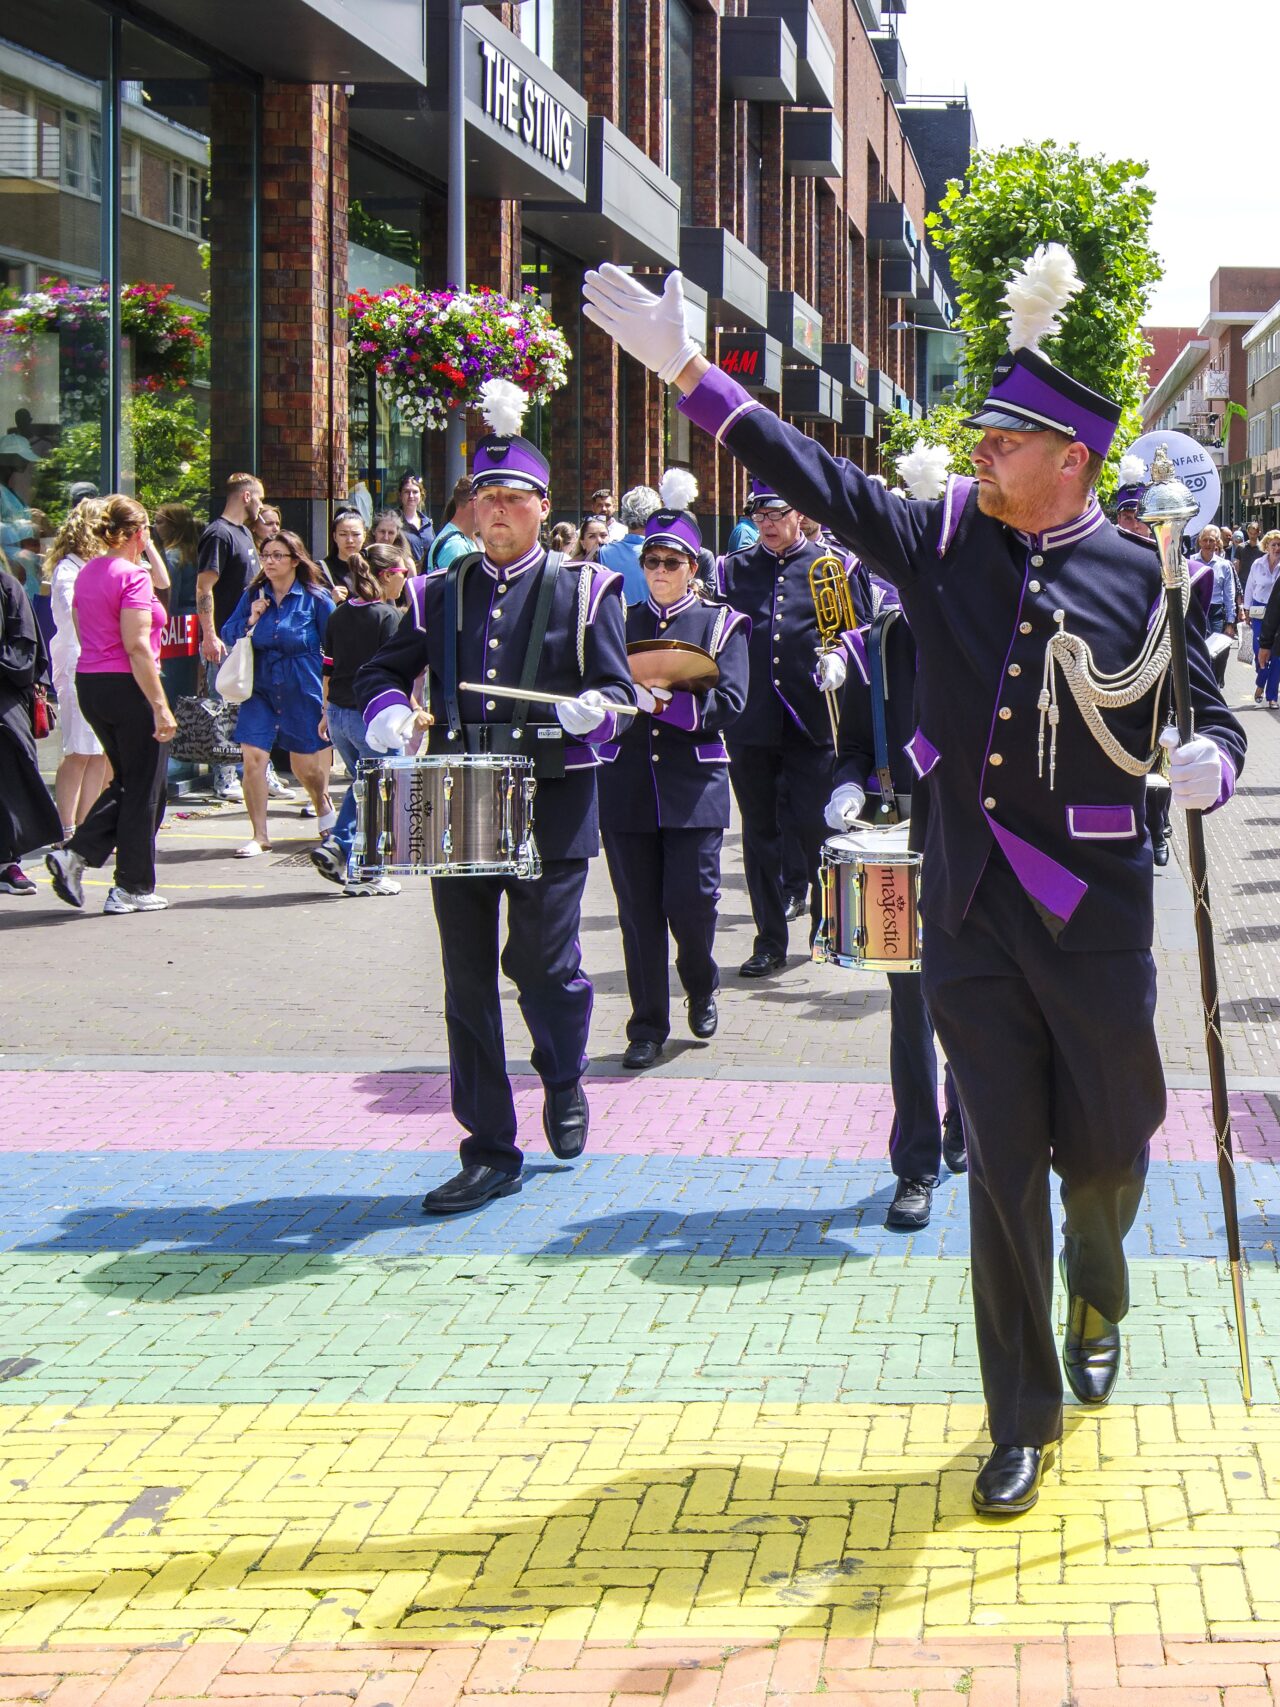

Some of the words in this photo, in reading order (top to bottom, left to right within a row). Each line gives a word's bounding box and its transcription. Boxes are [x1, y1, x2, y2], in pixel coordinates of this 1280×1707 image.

[480, 40, 520, 134] THE
[521, 78, 572, 170] STING
[721, 350, 759, 375] H&M
[1172, 453, 1205, 467] NFARE
[161, 614, 192, 646] SALE
[404, 771, 425, 861] majestic
[877, 866, 901, 954] majestic
